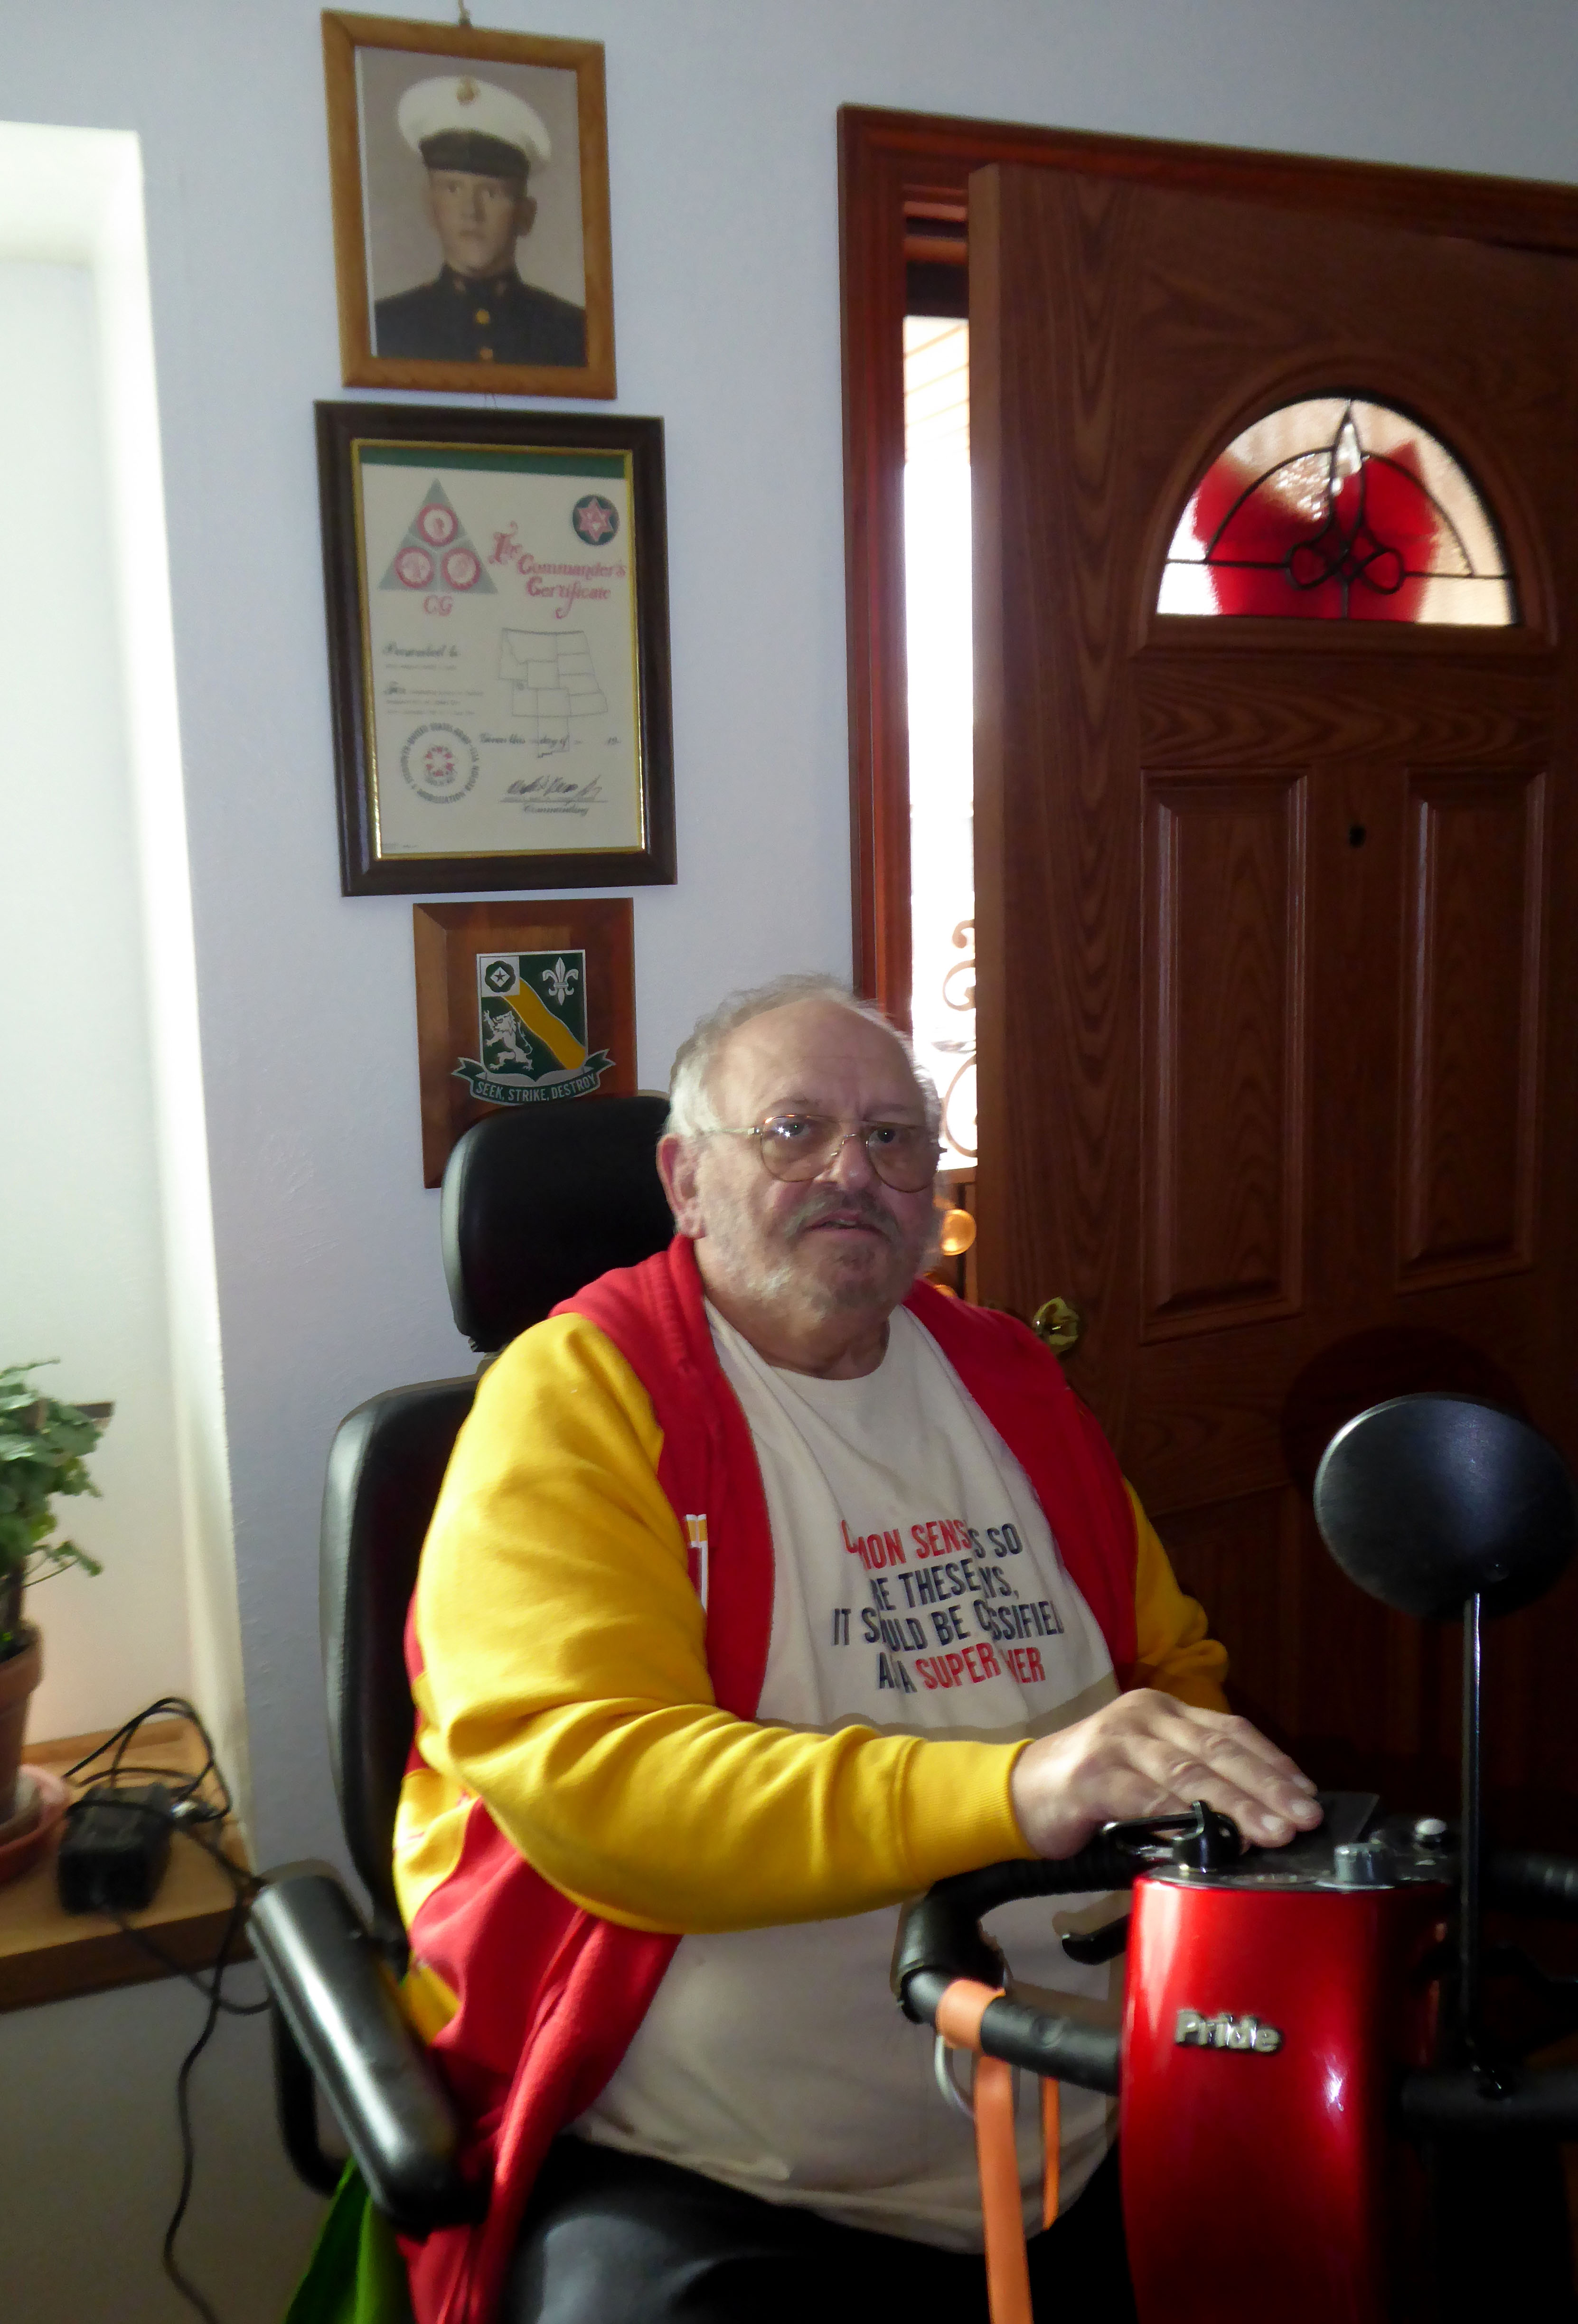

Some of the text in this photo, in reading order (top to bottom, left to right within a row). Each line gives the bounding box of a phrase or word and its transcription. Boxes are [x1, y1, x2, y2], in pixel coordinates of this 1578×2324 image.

[476, 1072, 597, 1102] SEEK, STRIKE, DESTROY
[987, 1523, 1023, 1557] SO
[898, 1557, 981, 1608] THESE
[834, 1608, 852, 1646] IT
[931, 1604, 971, 1646] BE
[1174, 2008, 1283, 2053] Pride
